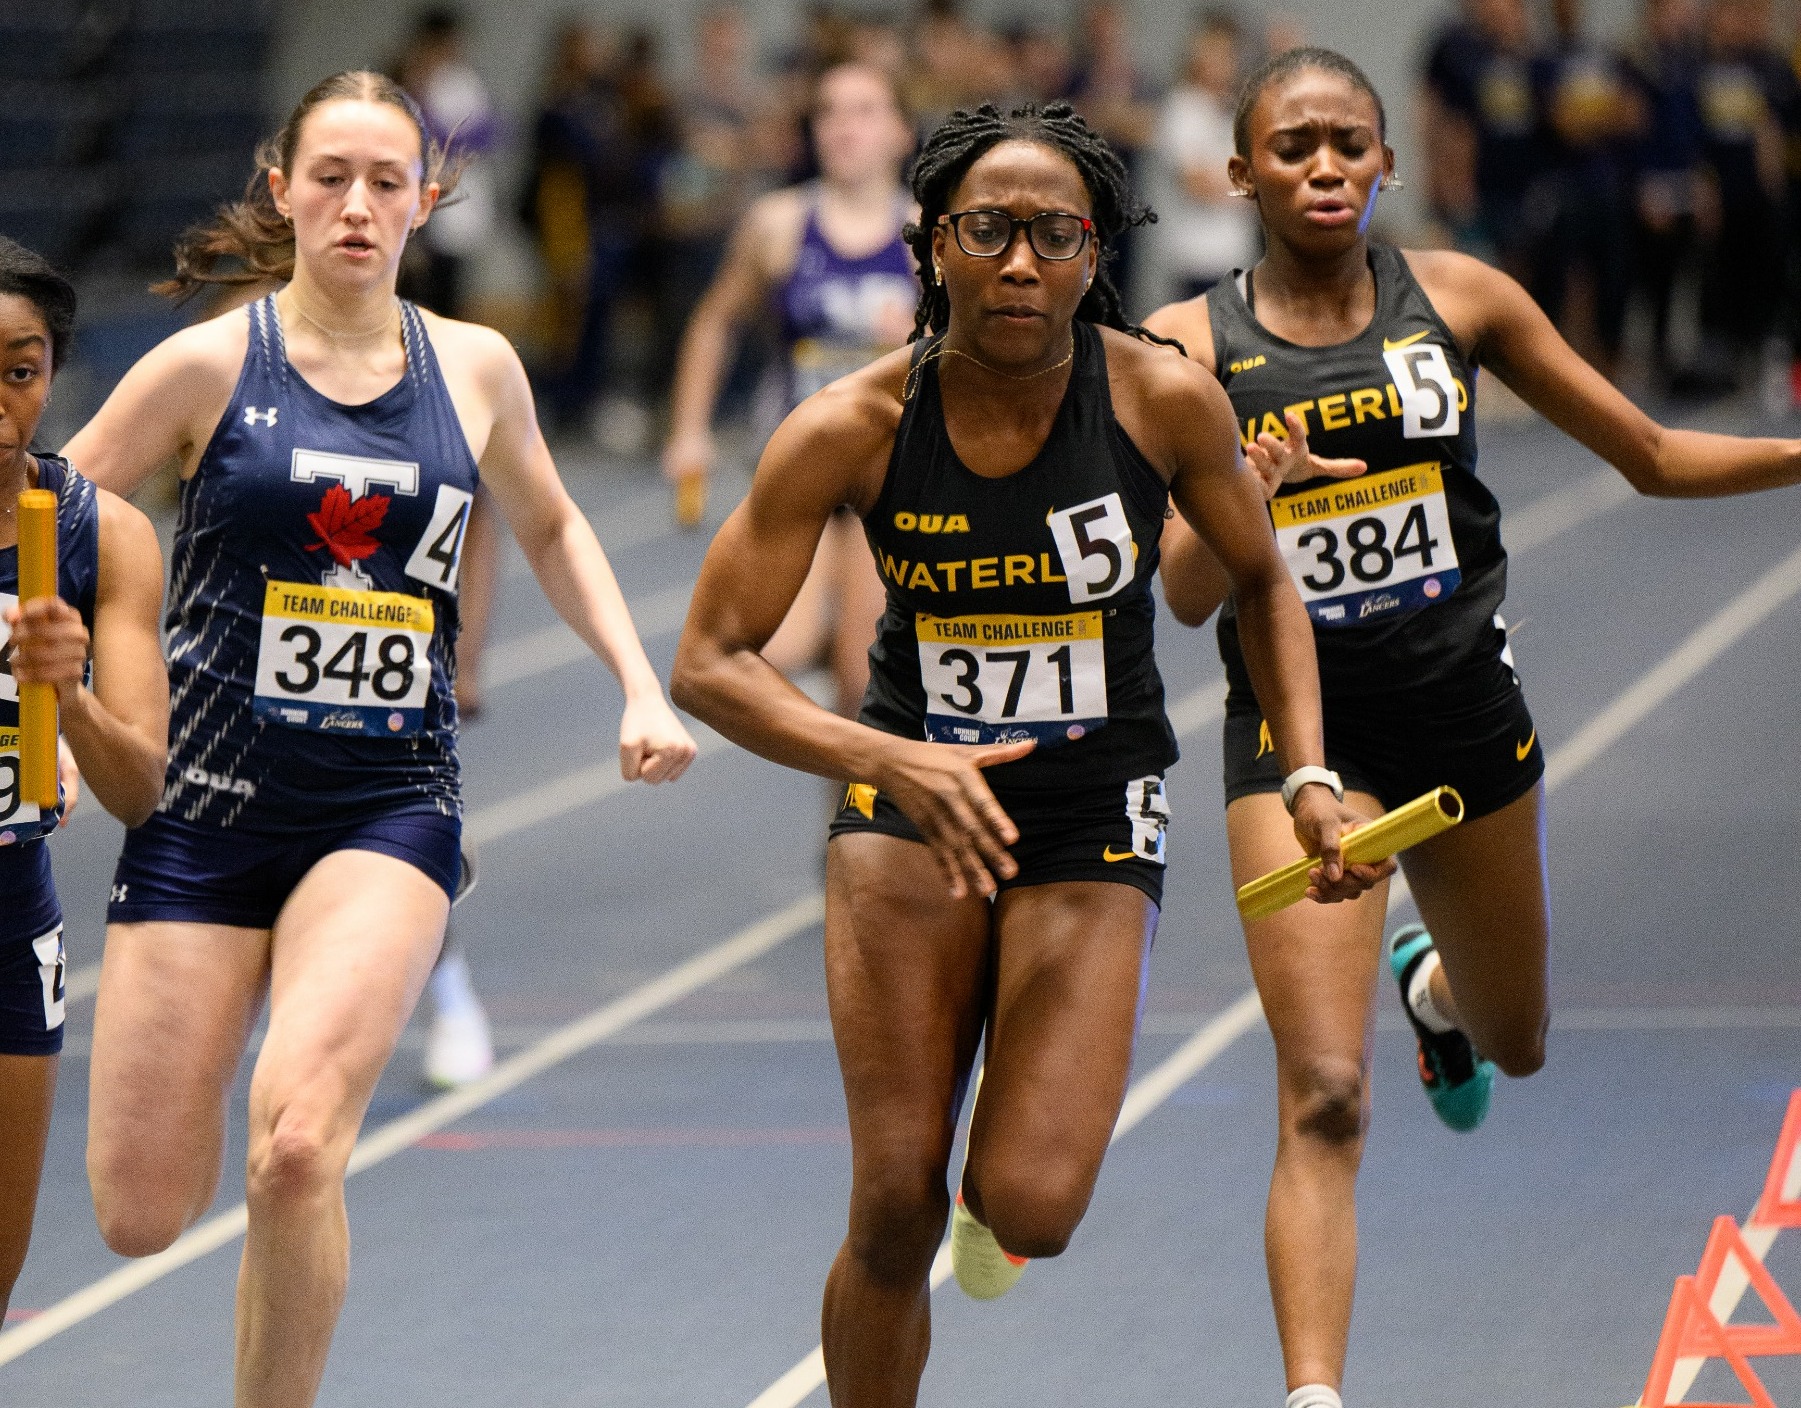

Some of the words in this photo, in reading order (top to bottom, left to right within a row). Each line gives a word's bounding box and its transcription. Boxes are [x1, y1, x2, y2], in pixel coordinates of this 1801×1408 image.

[1230, 354, 1267, 374] OUA
[1403, 350, 1449, 431] 5
[1240, 377, 1468, 450] ATERL
[894, 511, 971, 535] OUA
[1289, 497, 1331, 520] TEAM
[1335, 477, 1417, 511] CHALLENGE
[426, 501, 471, 584] 4
[878, 546, 1139, 593] WATERL
[1068, 503, 1122, 595] 5
[1297, 503, 1439, 593] 384
[282, 594, 324, 615] TEAM
[329, 599, 413, 624] CHALLENGE
[934, 622, 977, 639] TEAM
[982, 620, 1074, 640] CHALLENGE
[274, 625, 415, 702] 348
[938, 644, 1075, 719] 371
